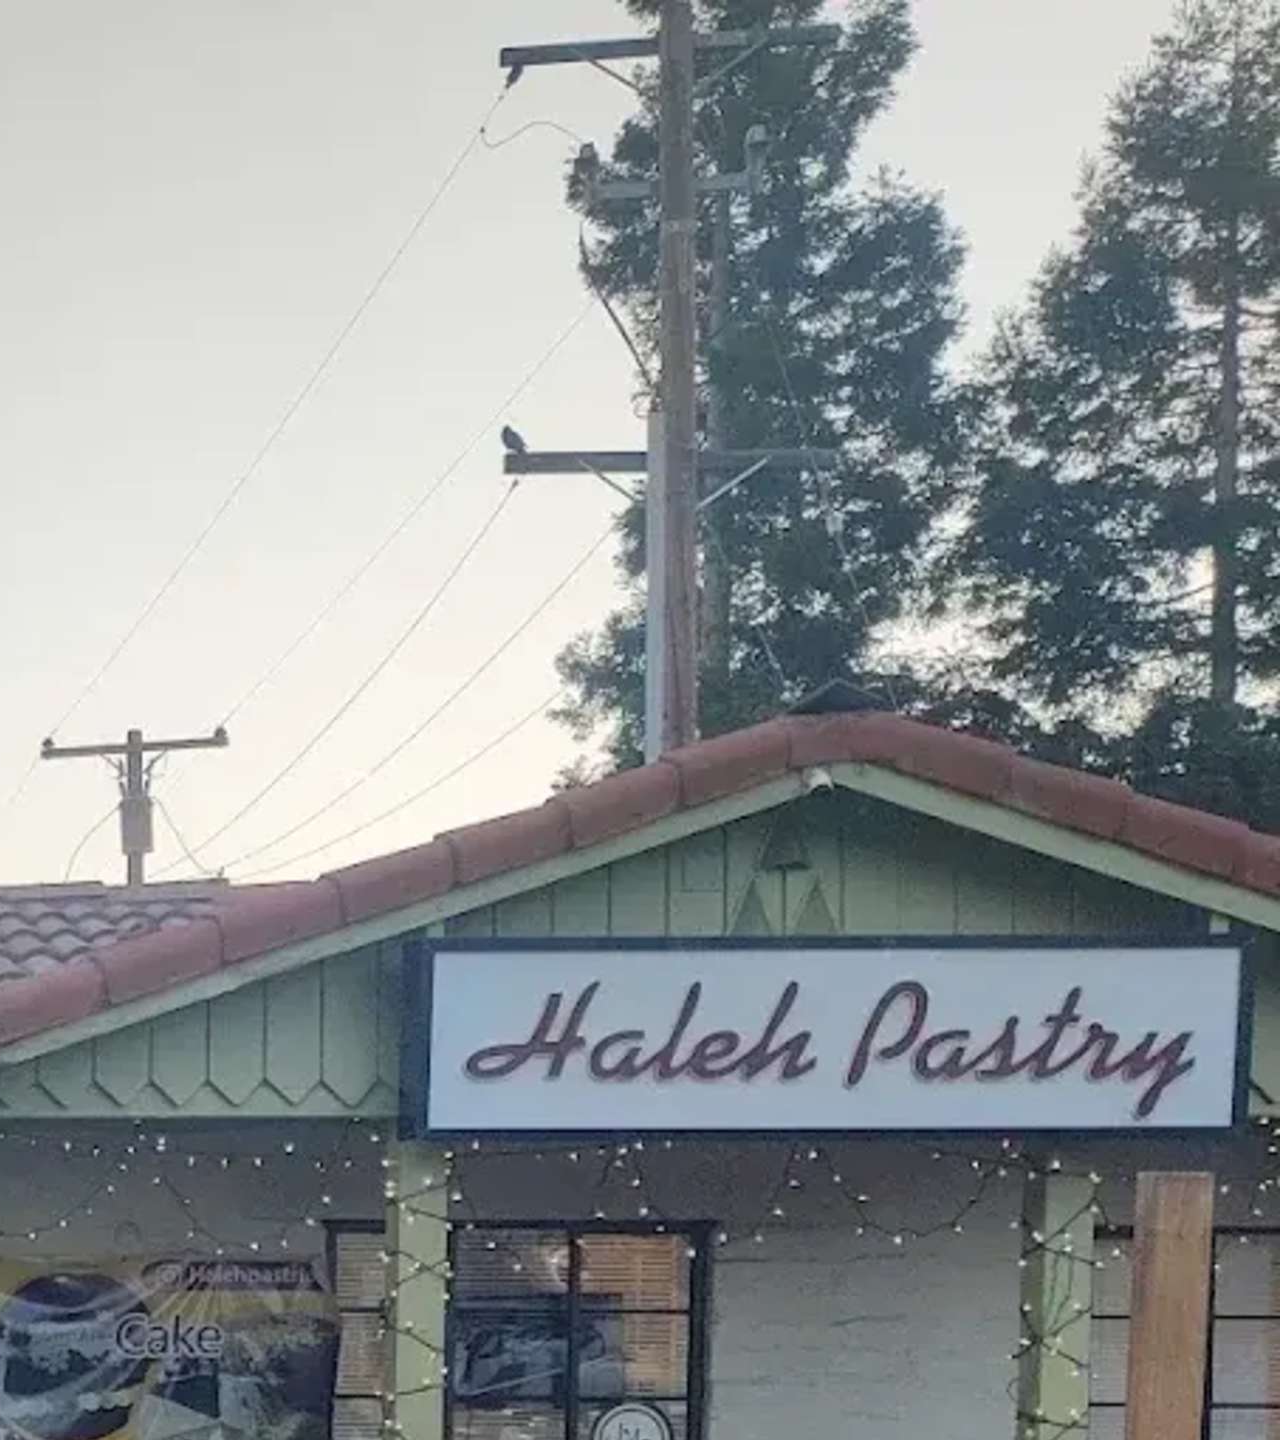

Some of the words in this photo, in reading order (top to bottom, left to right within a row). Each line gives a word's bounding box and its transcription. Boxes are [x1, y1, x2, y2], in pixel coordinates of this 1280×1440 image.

[463, 980, 818, 1082] Haleh
[843, 980, 1196, 1118] Pastry
[115, 1312, 224, 1359] Cake
